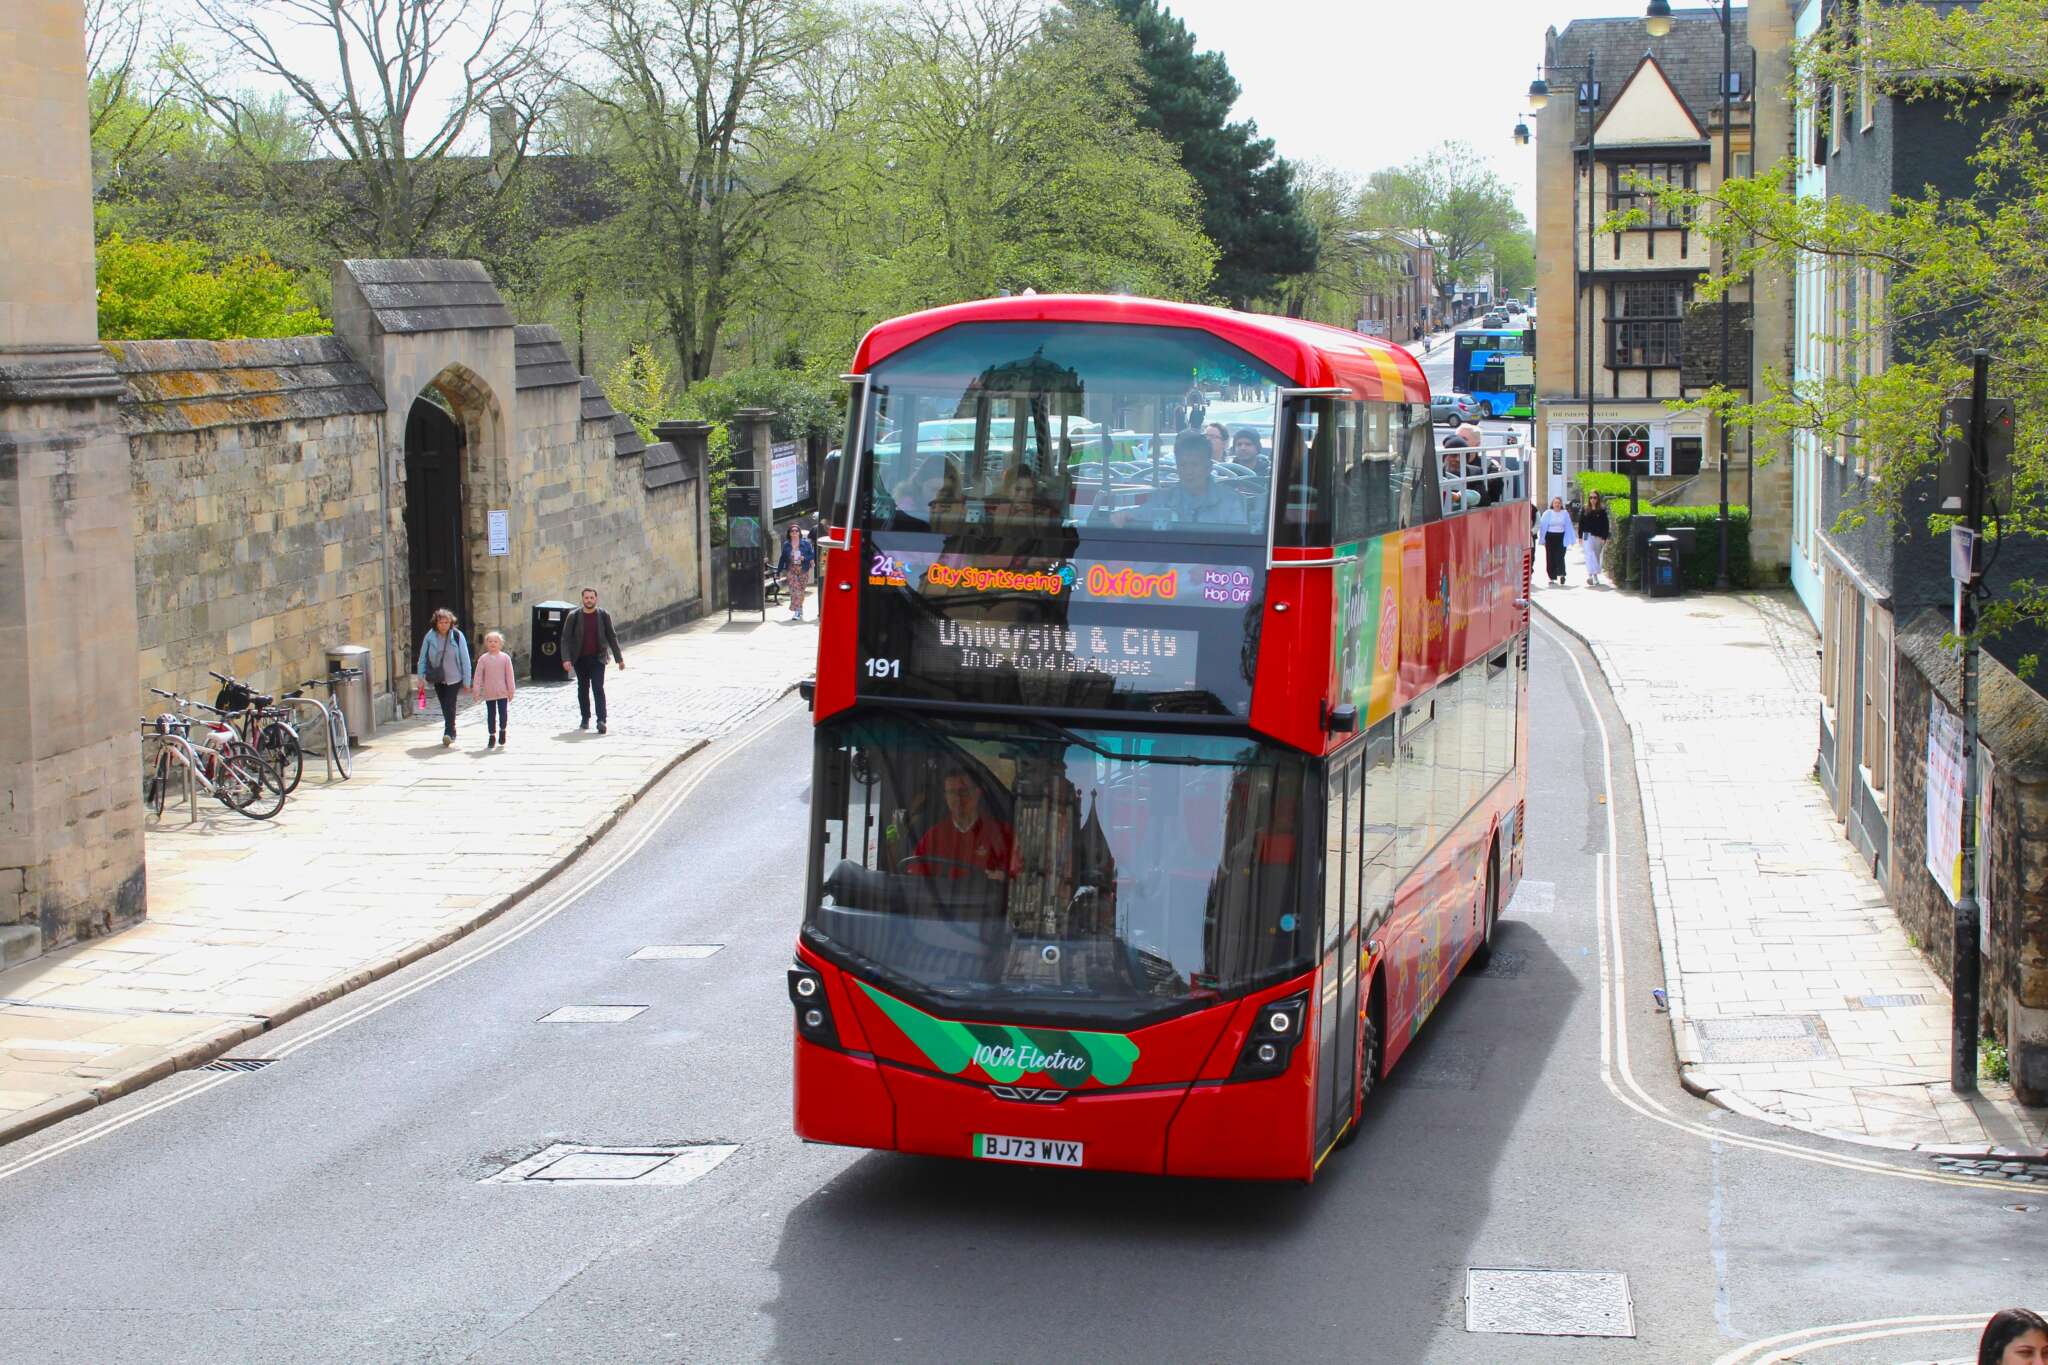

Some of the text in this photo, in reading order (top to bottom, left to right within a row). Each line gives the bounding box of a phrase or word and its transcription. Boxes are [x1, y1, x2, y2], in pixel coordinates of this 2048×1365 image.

[1628, 445, 1640, 454] 20
[871, 555, 893, 575] 24
[961, 566, 1062, 594] Sightseeing
[1088, 564, 1178, 599] Oxford
[1204, 570, 1250, 586] Hop On
[1204, 587, 1252, 602] Hop Off
[939, 619, 1177, 657] University & City
[865, 658, 900, 679] 191
[961, 649, 980, 668] In
[1012, 651, 1031, 671] to
[1035, 653, 1056, 672] 14
[1060, 653, 1152, 676] languages
[973, 1044, 1086, 1071] 100% Electric
[986, 1137, 1078, 1162] BJ73 WVX
